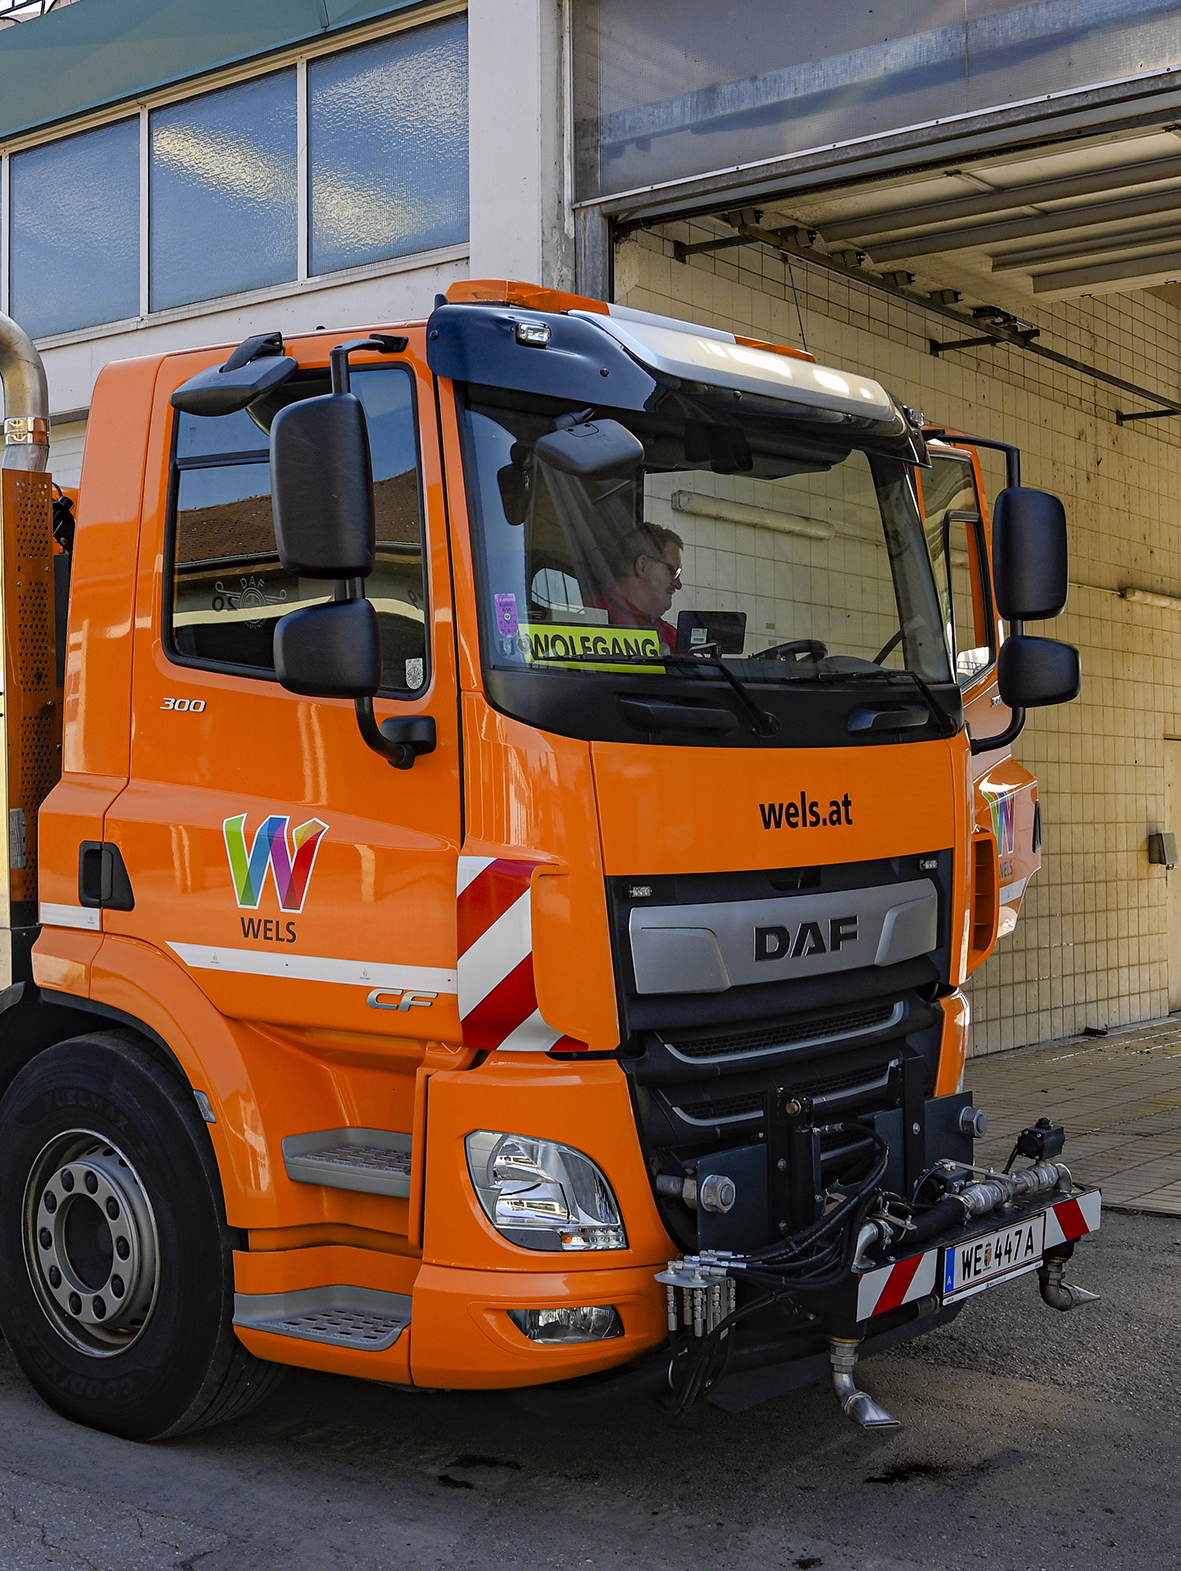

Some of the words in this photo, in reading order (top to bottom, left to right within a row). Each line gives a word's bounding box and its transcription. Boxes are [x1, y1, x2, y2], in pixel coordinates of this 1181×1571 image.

[526, 633, 659, 660] WOLFGANG
[159, 697, 207, 712] 300
[758, 790, 853, 829] wels.at
[240, 917, 297, 943] WELS
[753, 915, 859, 962] DAF
[366, 988, 438, 1012] CF
[961, 1243, 984, 1281] WE
